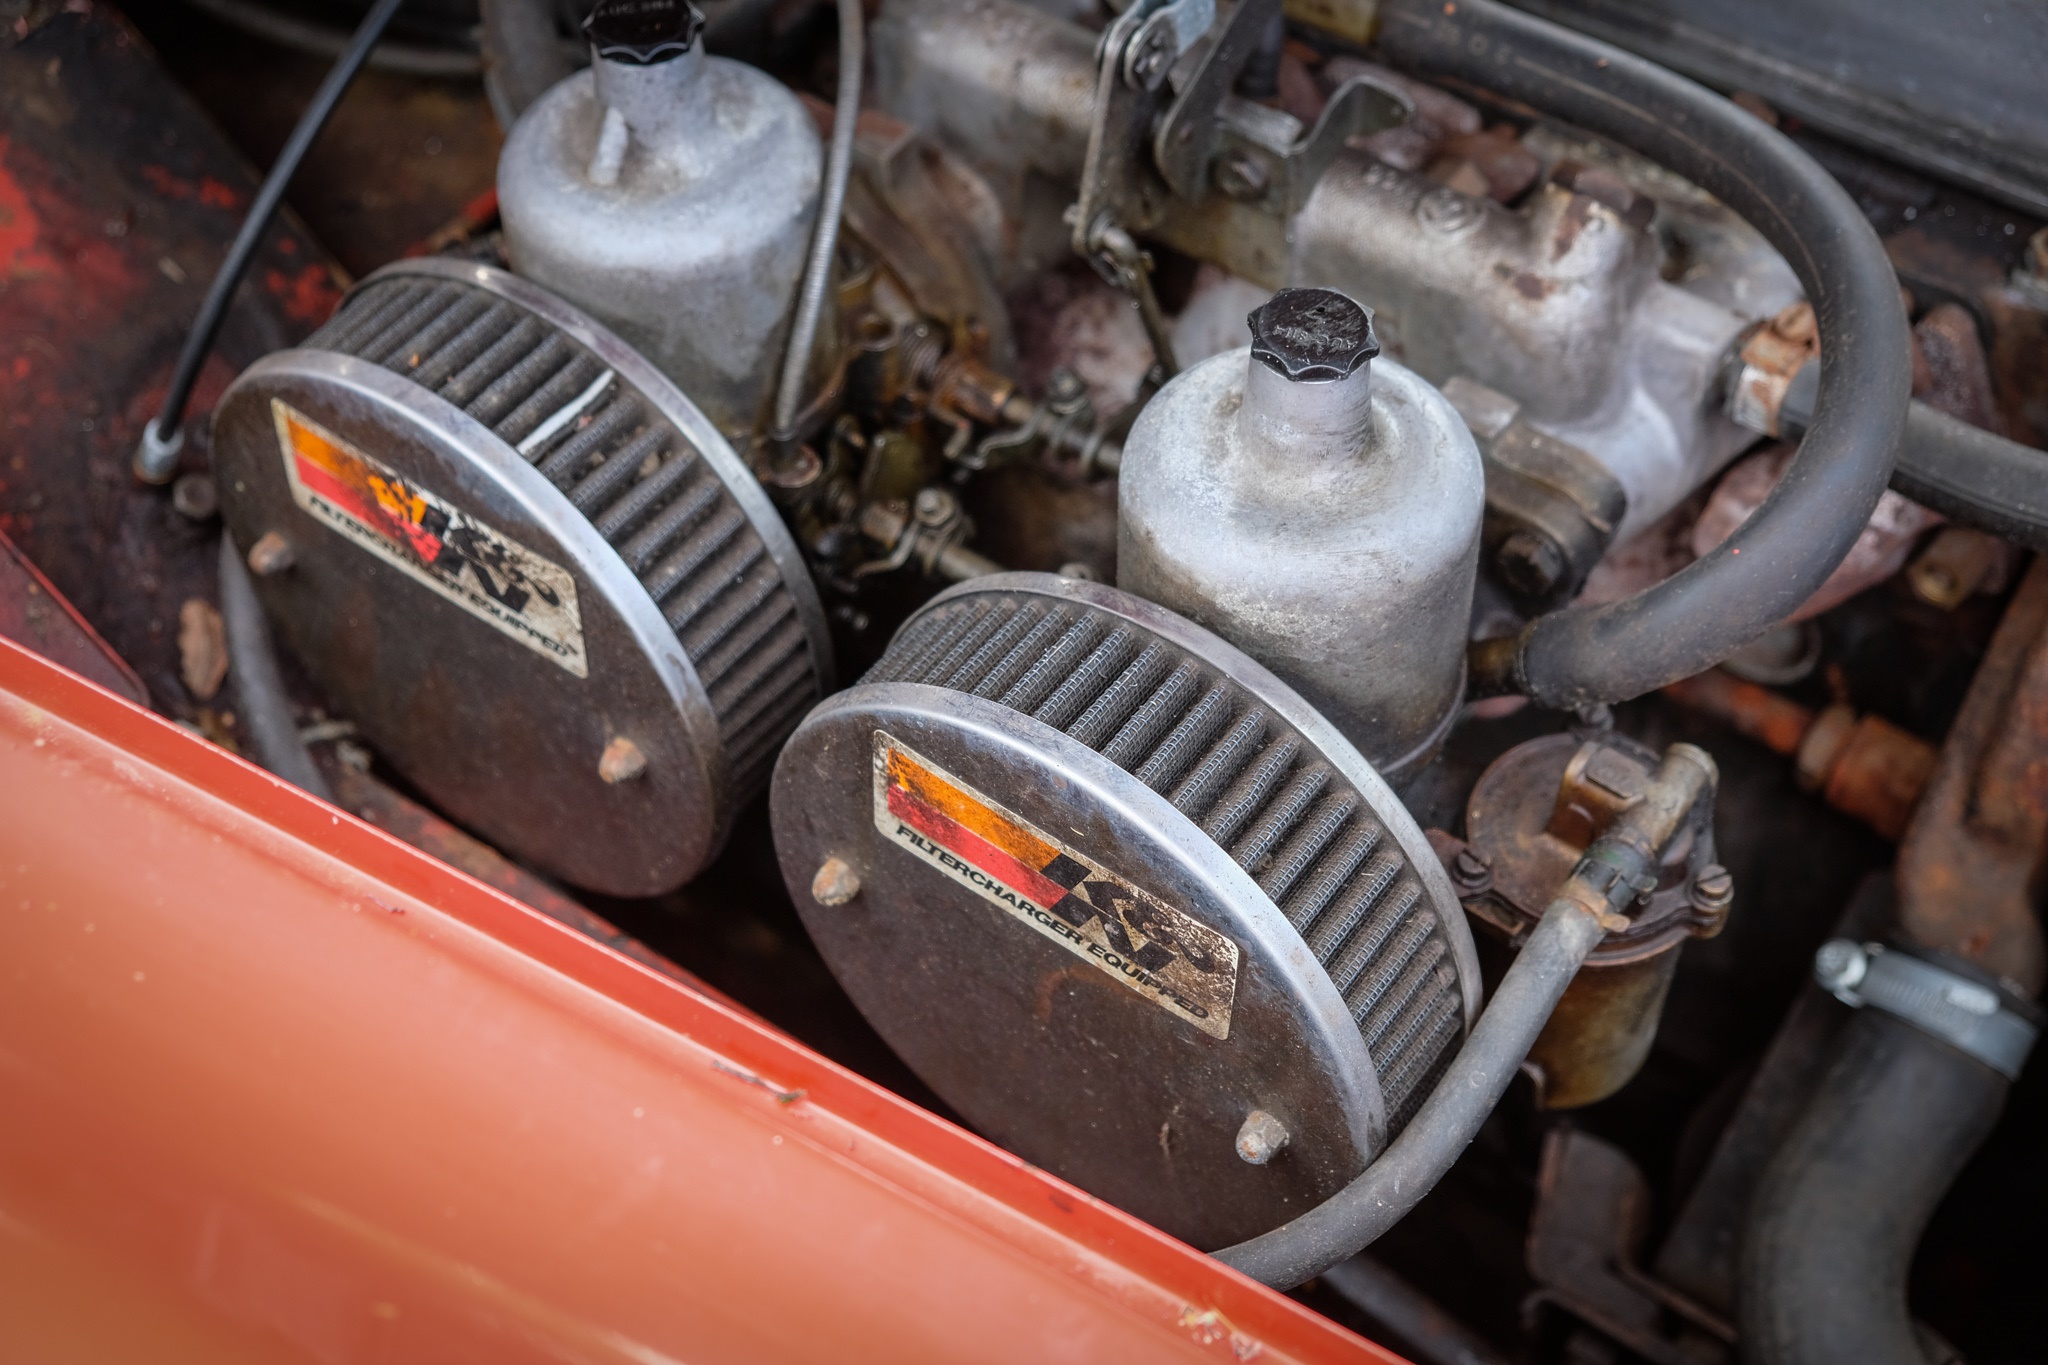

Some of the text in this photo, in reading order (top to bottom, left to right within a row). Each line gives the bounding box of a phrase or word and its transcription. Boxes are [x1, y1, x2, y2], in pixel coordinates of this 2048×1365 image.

[468, 593, 569, 657] EQUIPPED
[895, 824, 1209, 1019] FILTERCHARGER EQUIPPED
